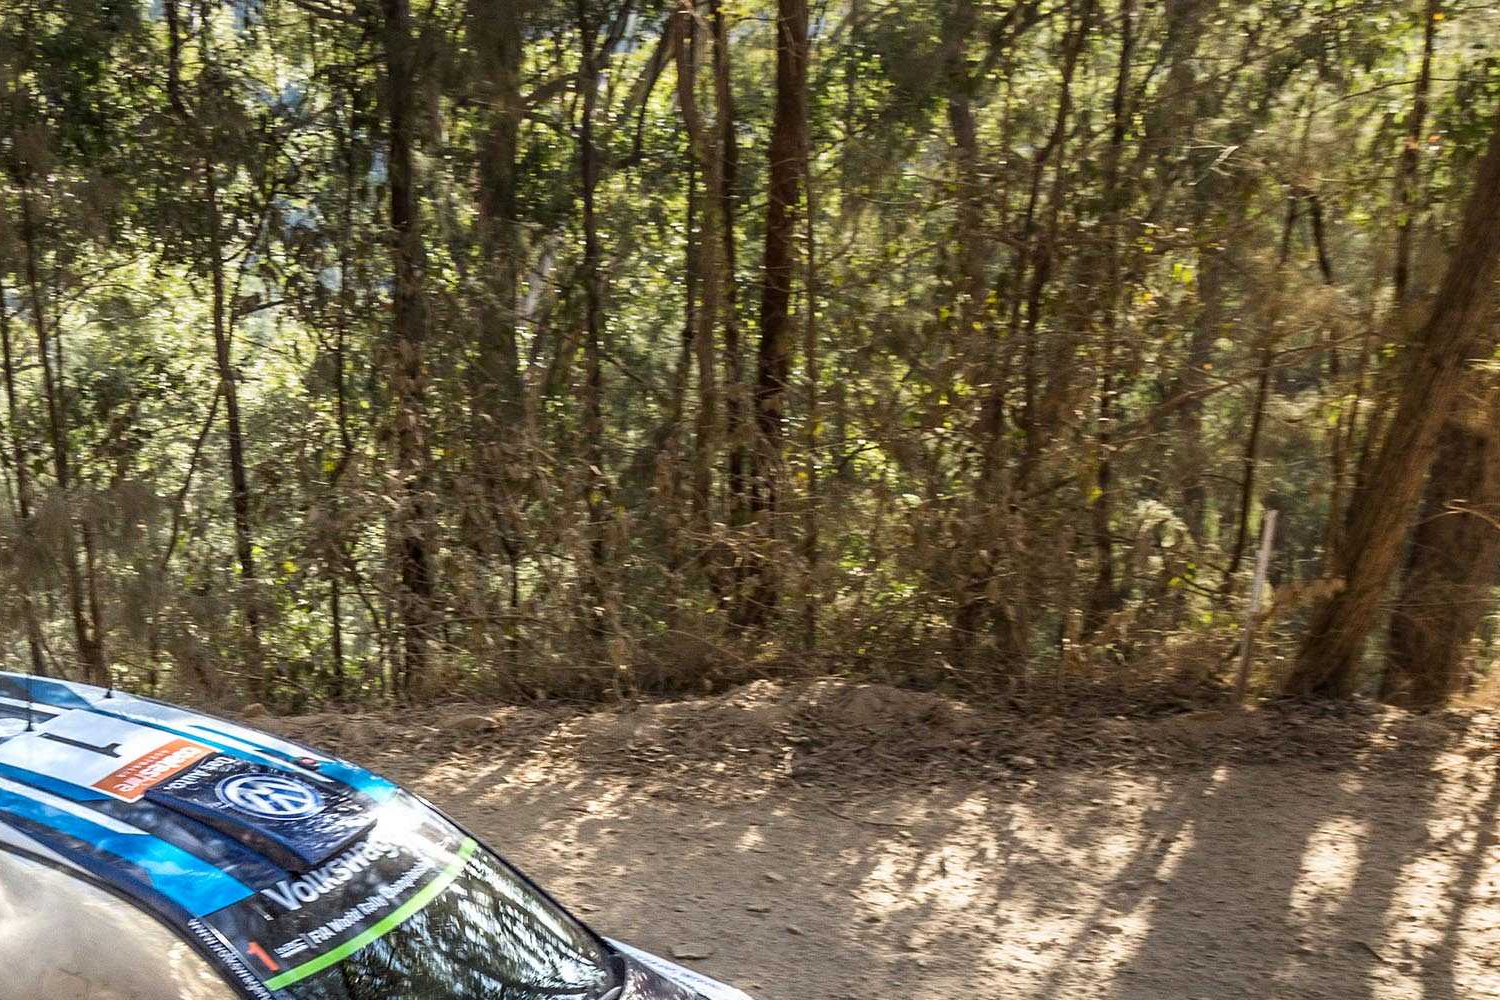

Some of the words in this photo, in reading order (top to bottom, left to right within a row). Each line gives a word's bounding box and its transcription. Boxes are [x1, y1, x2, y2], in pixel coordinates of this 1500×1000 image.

[200, 756, 237, 771] Das
[261, 838, 401, 912] Volkswag
[246, 942, 280, 972] 1
